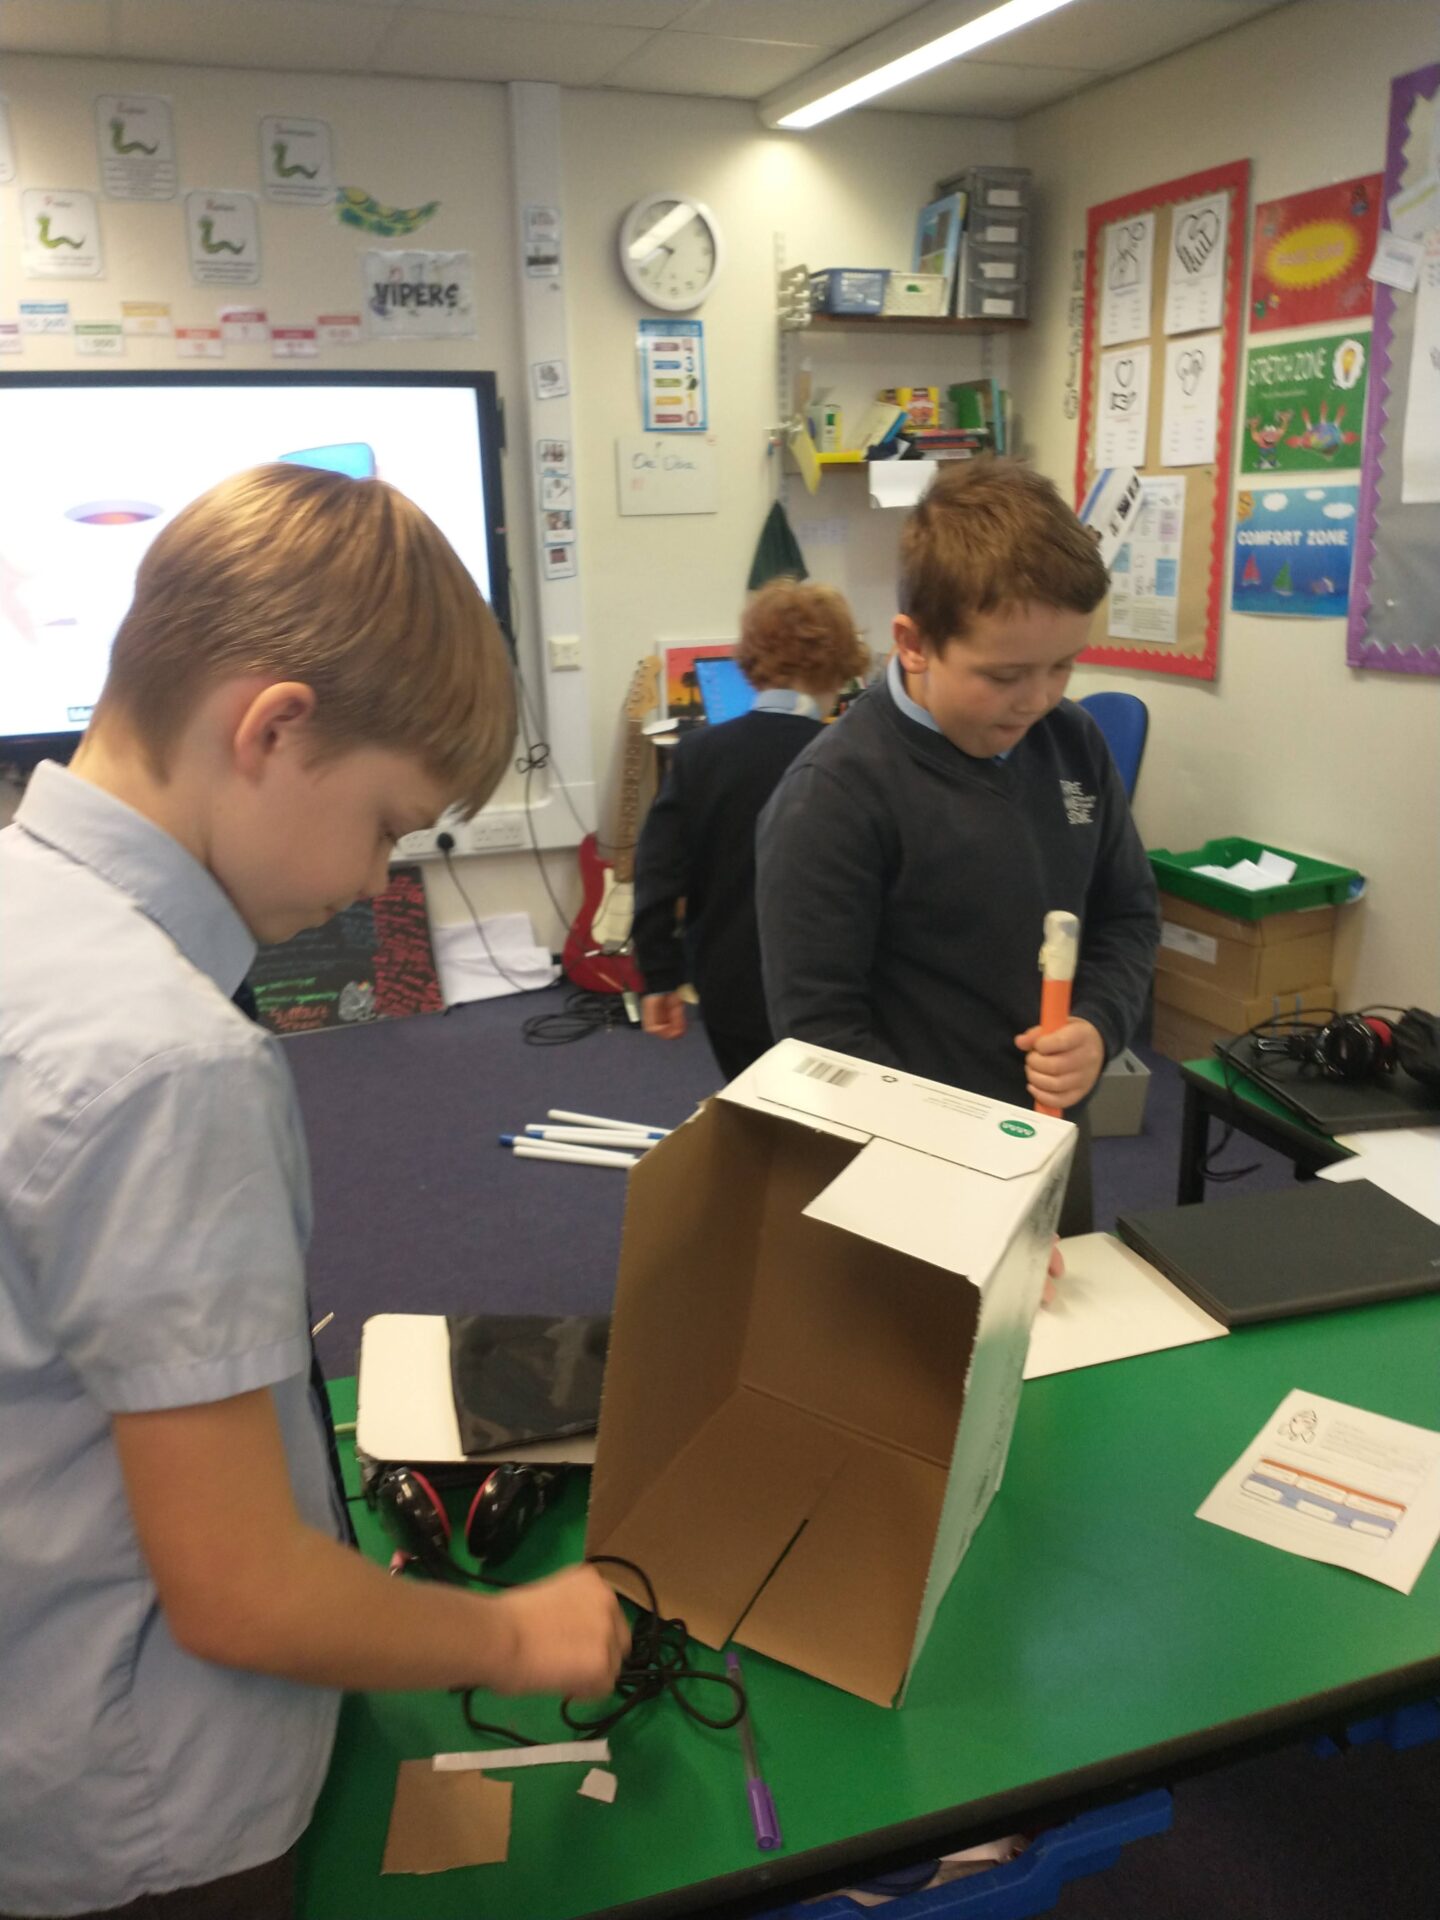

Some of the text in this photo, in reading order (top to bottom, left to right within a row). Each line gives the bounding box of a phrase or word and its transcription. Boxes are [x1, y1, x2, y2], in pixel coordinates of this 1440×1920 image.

[374, 282, 460, 307] VIPERS
[1237, 529, 1348, 546] COMFORT ZONE
